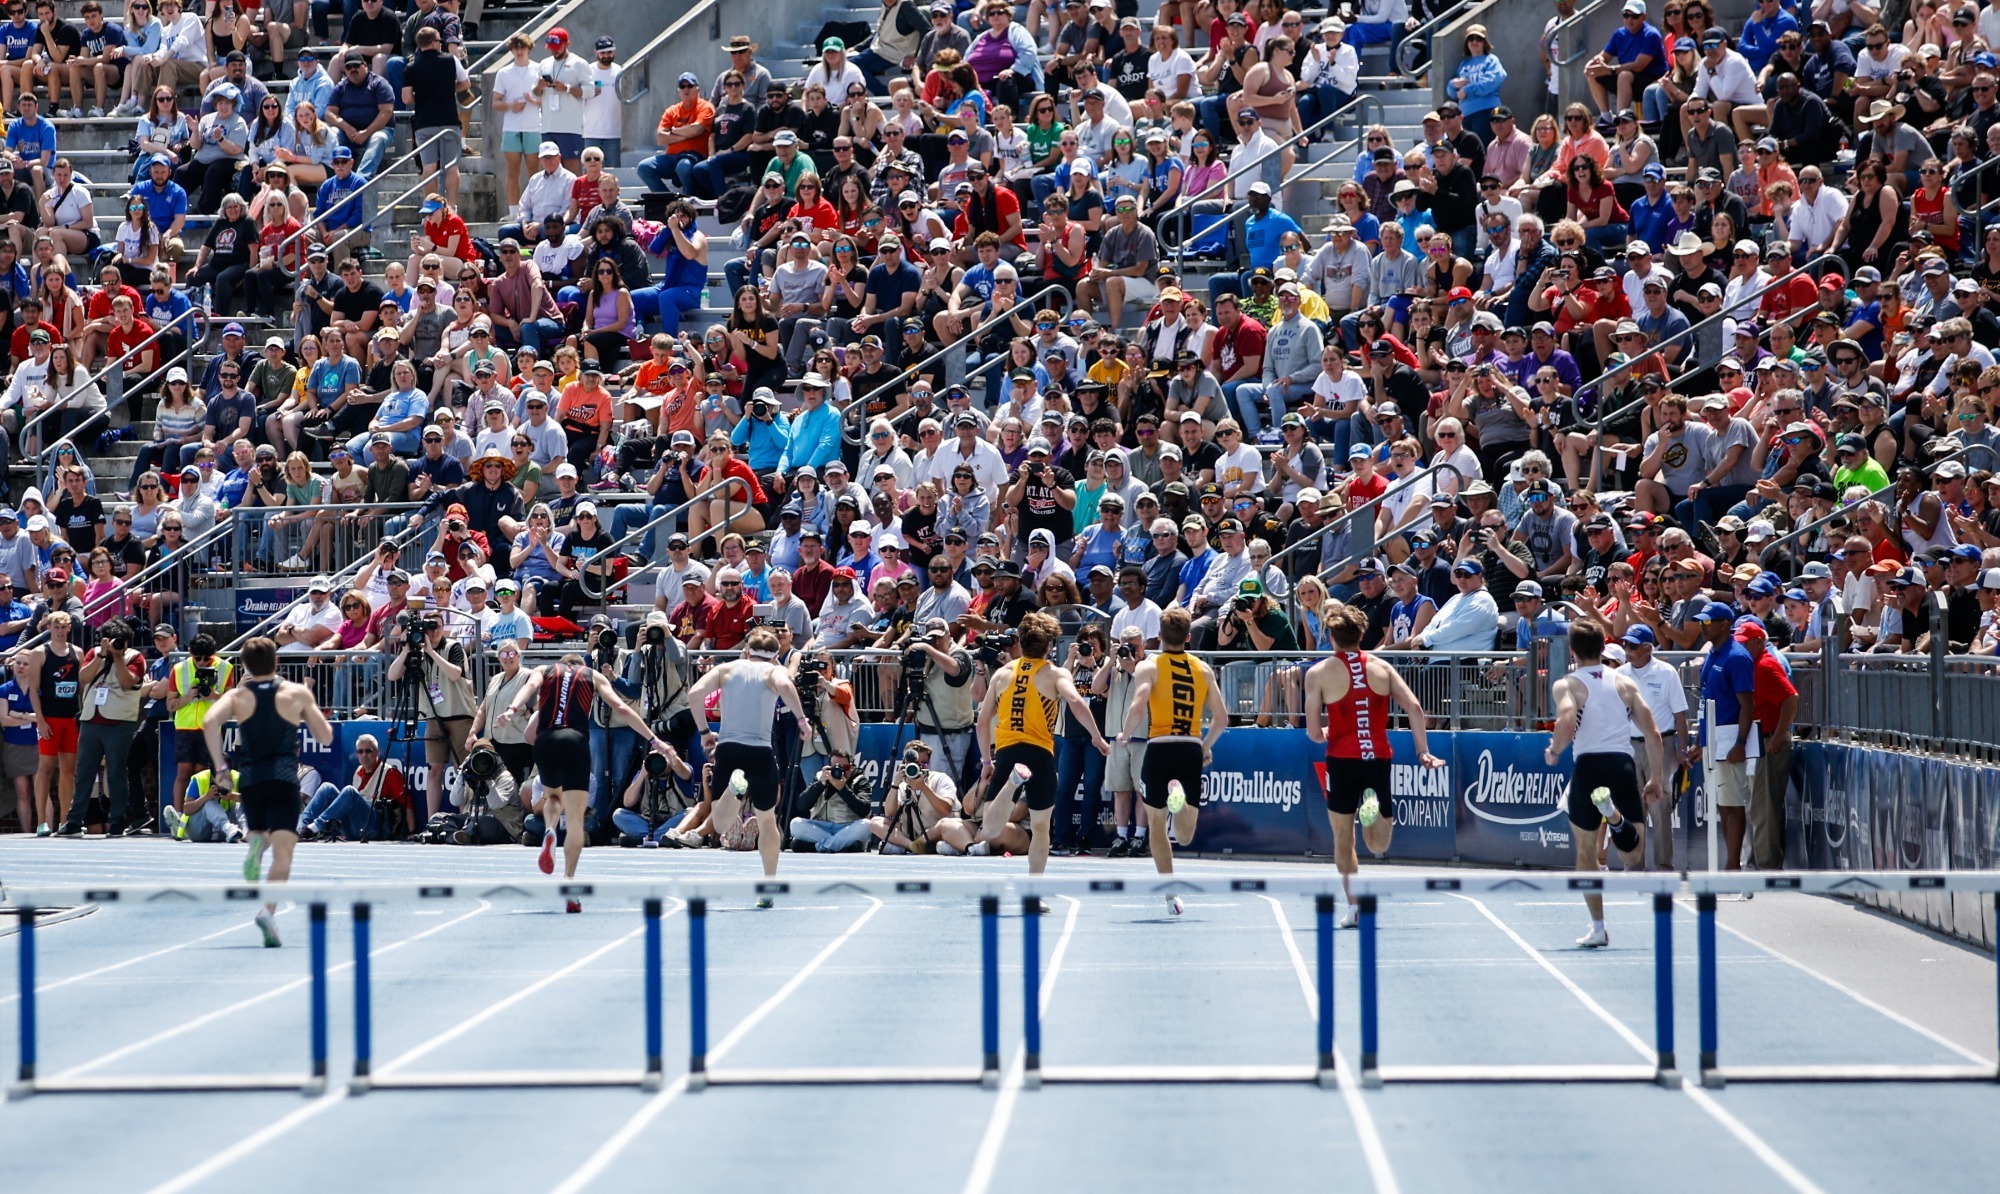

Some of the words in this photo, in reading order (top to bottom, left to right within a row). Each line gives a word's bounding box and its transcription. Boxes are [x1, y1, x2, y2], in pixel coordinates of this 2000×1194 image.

[6, 35, 28, 45] Drake
[1737, 184, 1758, 196] USA
[244, 598, 269, 612] Drake
[1345, 651, 1367, 689] ADM
[558, 670, 572, 711] MOUNT
[1354, 697, 1375, 761] TIGERS
[1198, 771, 1301, 813] @DUBulldogs
[1475, 749, 1525, 804] Drake
[1523, 772, 1564, 805] RELAYS
